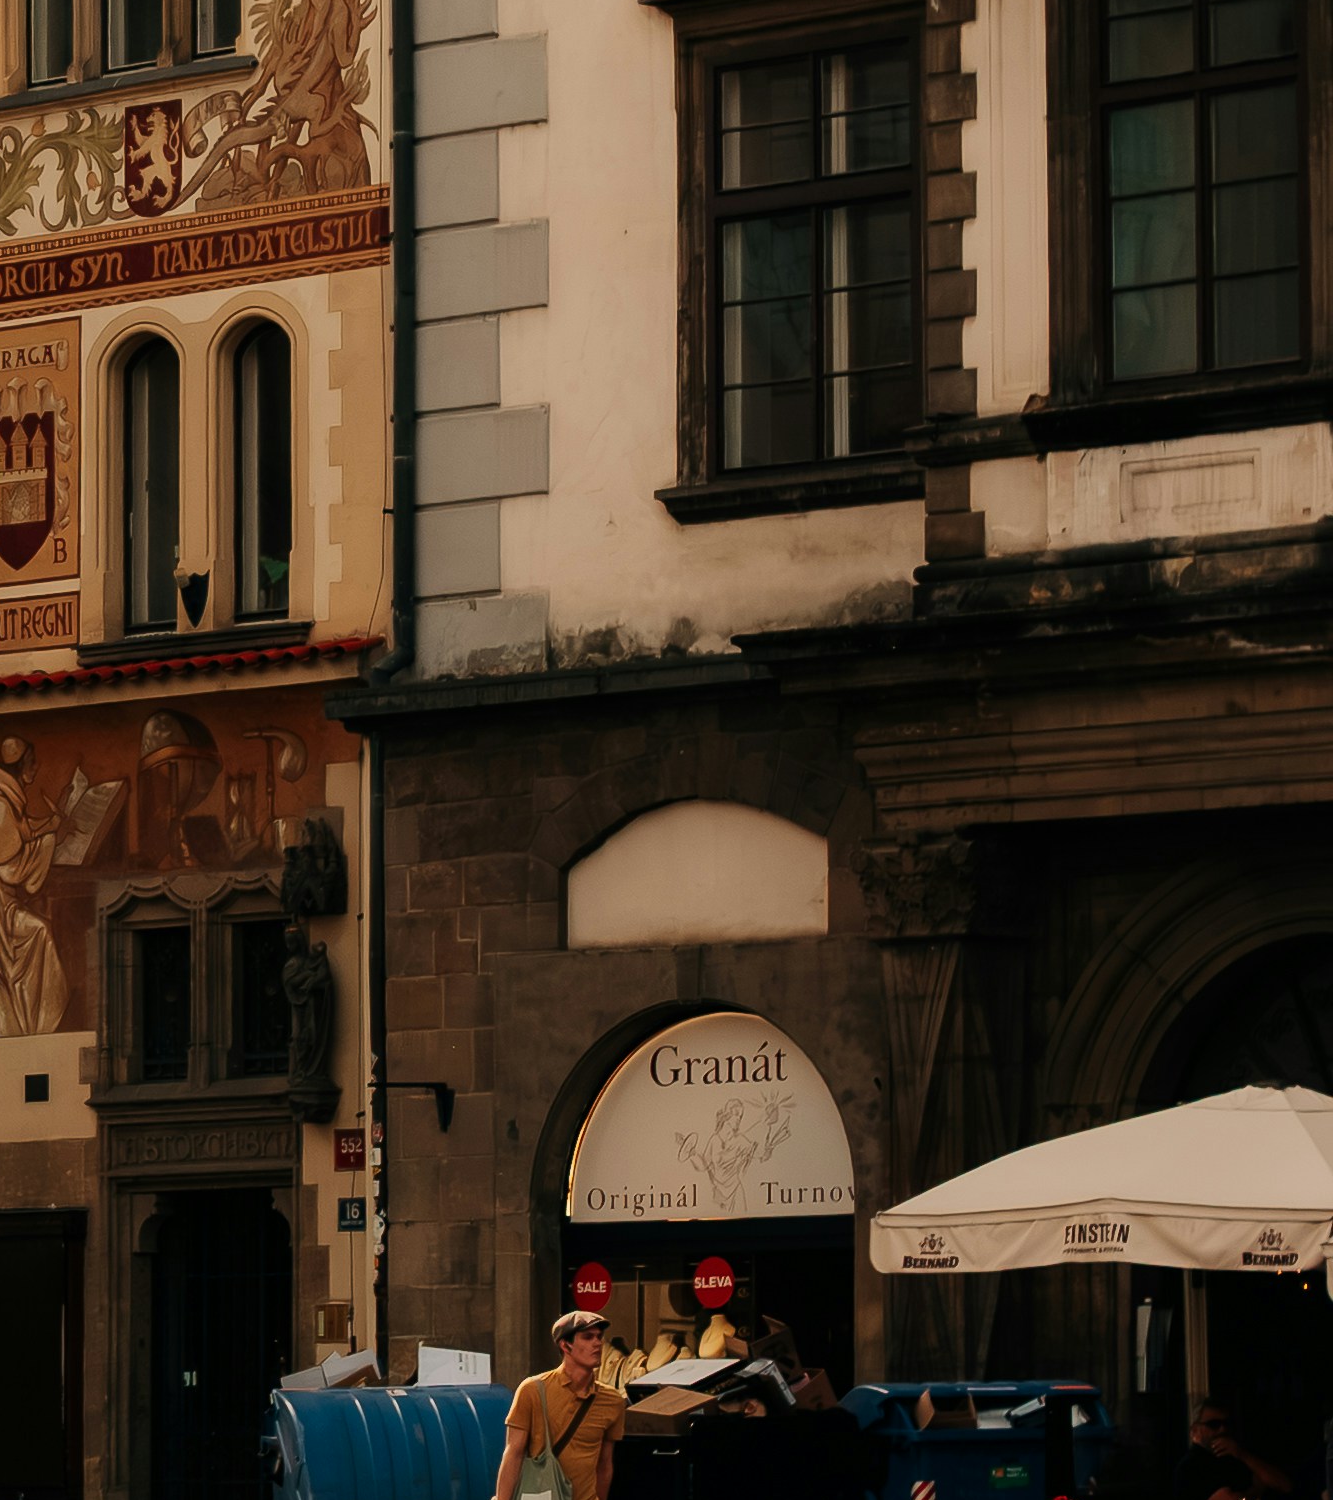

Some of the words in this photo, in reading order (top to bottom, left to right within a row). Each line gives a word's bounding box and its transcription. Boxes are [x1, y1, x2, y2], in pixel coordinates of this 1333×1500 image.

[53, 538, 68, 564] B
[650, 1041, 789, 1088] Granát
[341, 1138, 363, 1154] 552
[587, 1183, 697, 1217] Originál
[345, 1202, 360, 1220] 16
[1064, 1222, 1130, 1245] EINSTEIN
[576, 1280, 607, 1294] SALE
[694, 1275, 733, 1289] SLEVA
